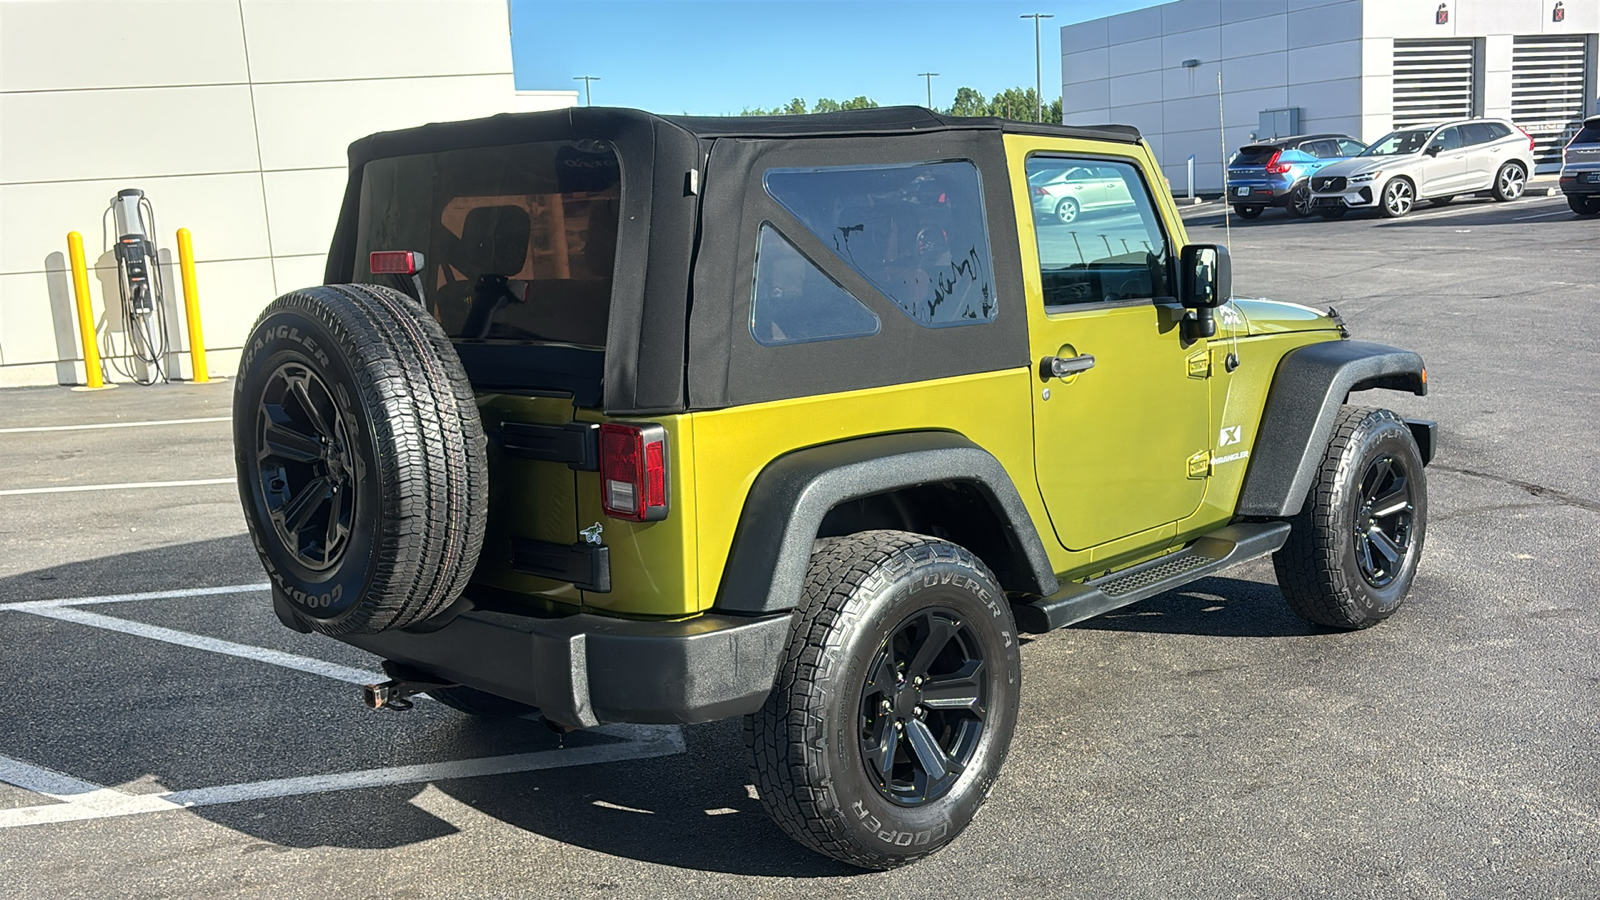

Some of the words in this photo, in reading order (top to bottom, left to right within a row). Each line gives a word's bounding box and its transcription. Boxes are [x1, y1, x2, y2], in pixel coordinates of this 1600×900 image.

[238, 325, 330, 393] WRANGLER
[1210, 450, 1249, 465] WRANGLER
[872, 571, 1002, 631] DISCOVERER
[851, 799, 948, 847] COOPER
